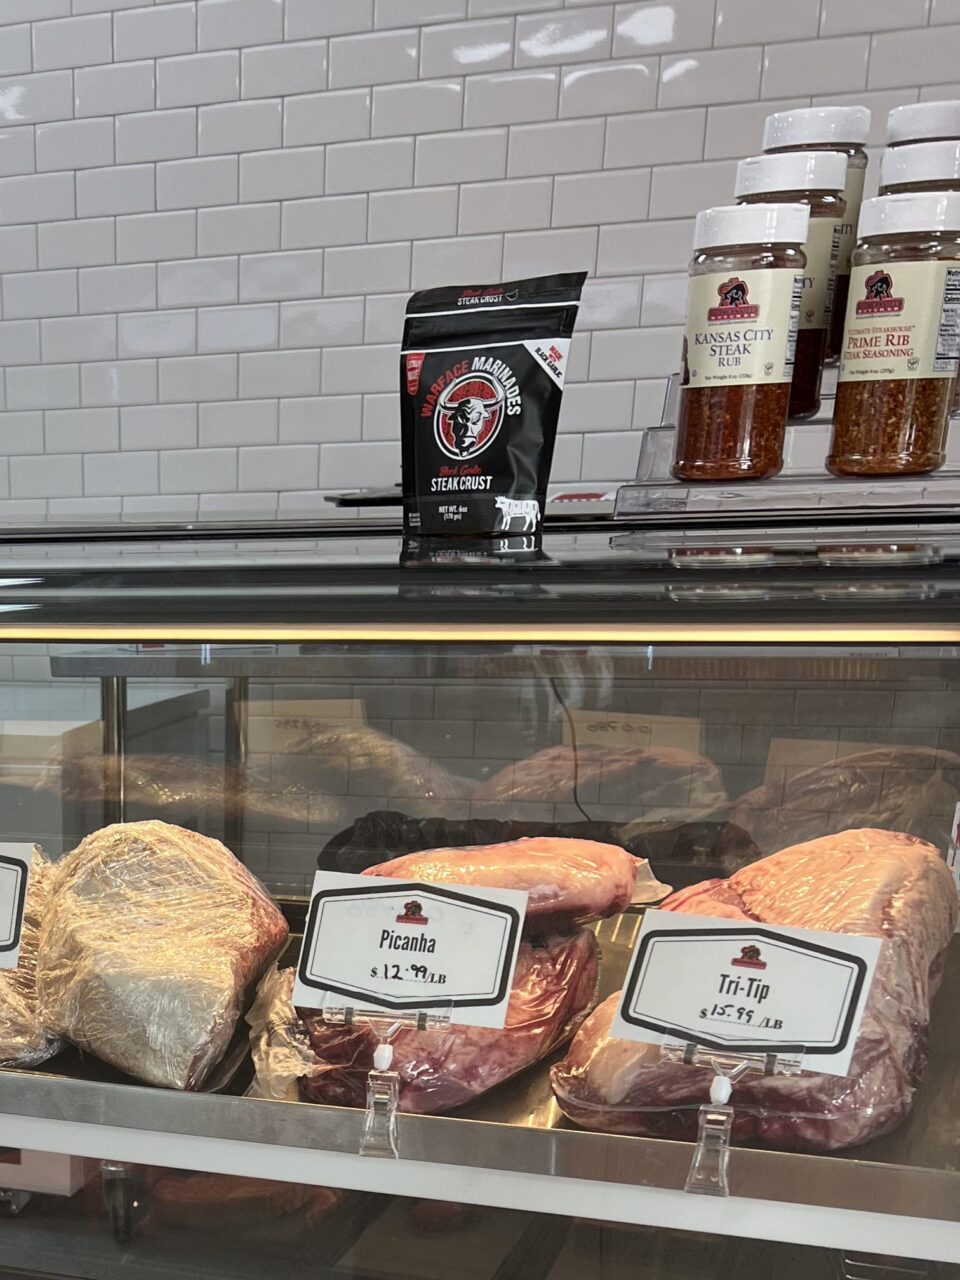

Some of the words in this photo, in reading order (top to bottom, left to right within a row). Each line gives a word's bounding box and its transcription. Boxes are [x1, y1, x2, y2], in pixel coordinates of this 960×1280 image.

[694, 330, 741, 345] KANSAS
[743, 328, 774, 342] CITY
[847, 335, 881, 349] PRIME
[885, 333, 910, 347] RIB
[710, 342, 752, 357] STEAK
[843, 350, 861, 361] STEAK
[862, 347, 914, 360] SEASONING
[718, 357, 741, 368] RUB
[420, 359, 470, 418] WARFACE
[471, 356, 522, 416] MARINADES
[431, 476, 460, 492] STEAK
[459, 475, 493, 491] CRUST
[379, 929, 437, 953] Picanha
[717, 973, 770, 1004] Tri-Tip
